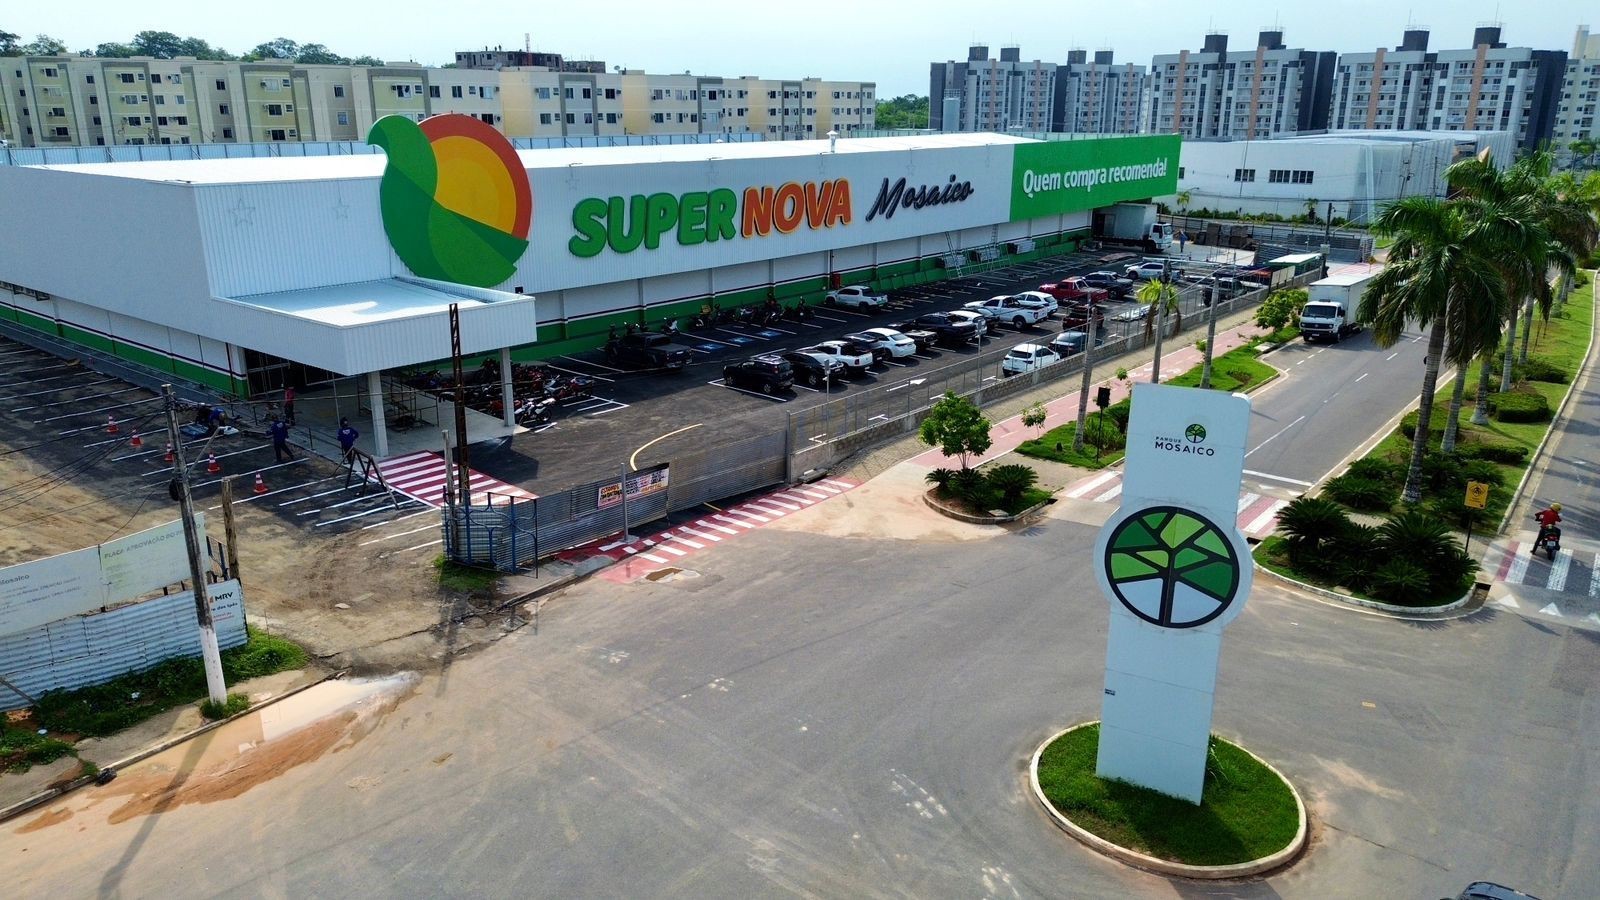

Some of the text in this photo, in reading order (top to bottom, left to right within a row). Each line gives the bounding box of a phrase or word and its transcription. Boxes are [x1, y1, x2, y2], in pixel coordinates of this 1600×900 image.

[1023, 157, 1168, 198] Quem compra recomenda!
[568, 174, 975, 257] SUPER NOVA Mosaico
[1155, 442, 1214, 456] MOSAICO
[104, 549, 124, 559] PLACA
[215, 592, 233, 601] MRV
